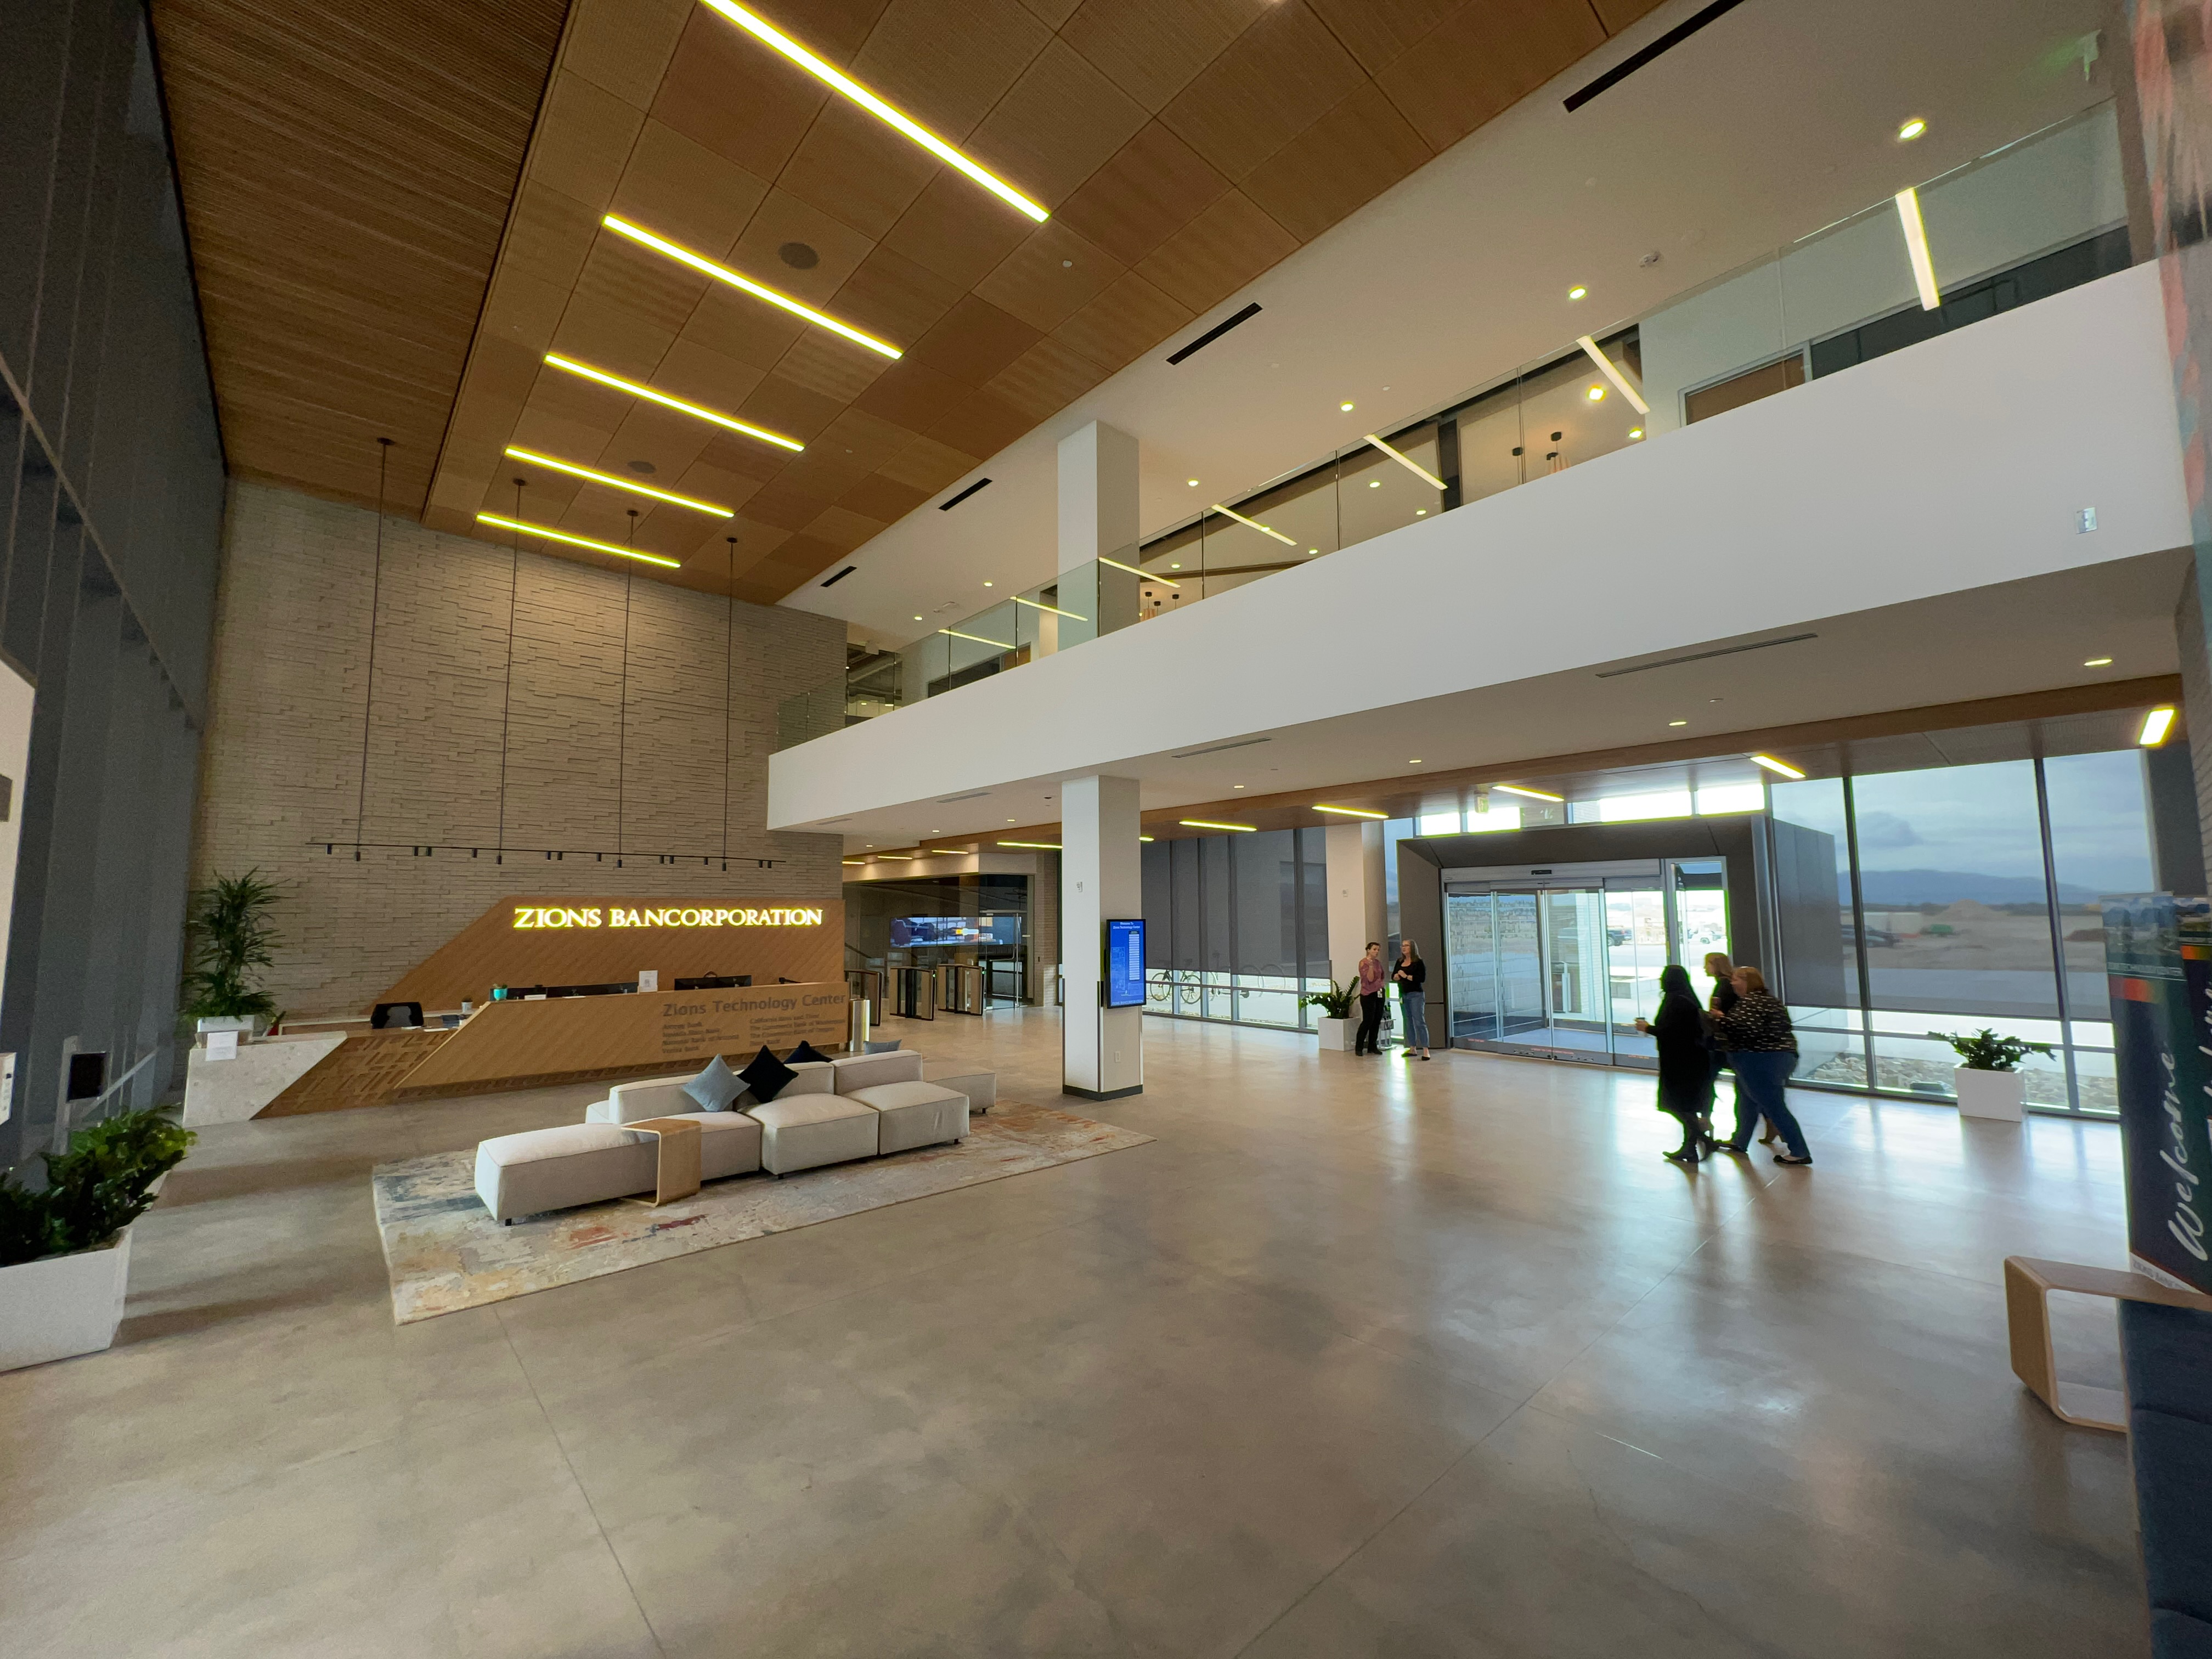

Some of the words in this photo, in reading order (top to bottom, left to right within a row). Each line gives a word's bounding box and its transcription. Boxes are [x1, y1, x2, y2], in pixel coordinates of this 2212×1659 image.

[513, 908, 602, 928] ZIONS
[608, 908, 823, 927] BANCORPORATION
[663, 1003, 706, 1017] Zions
[712, 997, 798, 1013] Technology
[802, 994, 846, 1007] Center
[2160, 1047, 2208, 1261] Welcome
